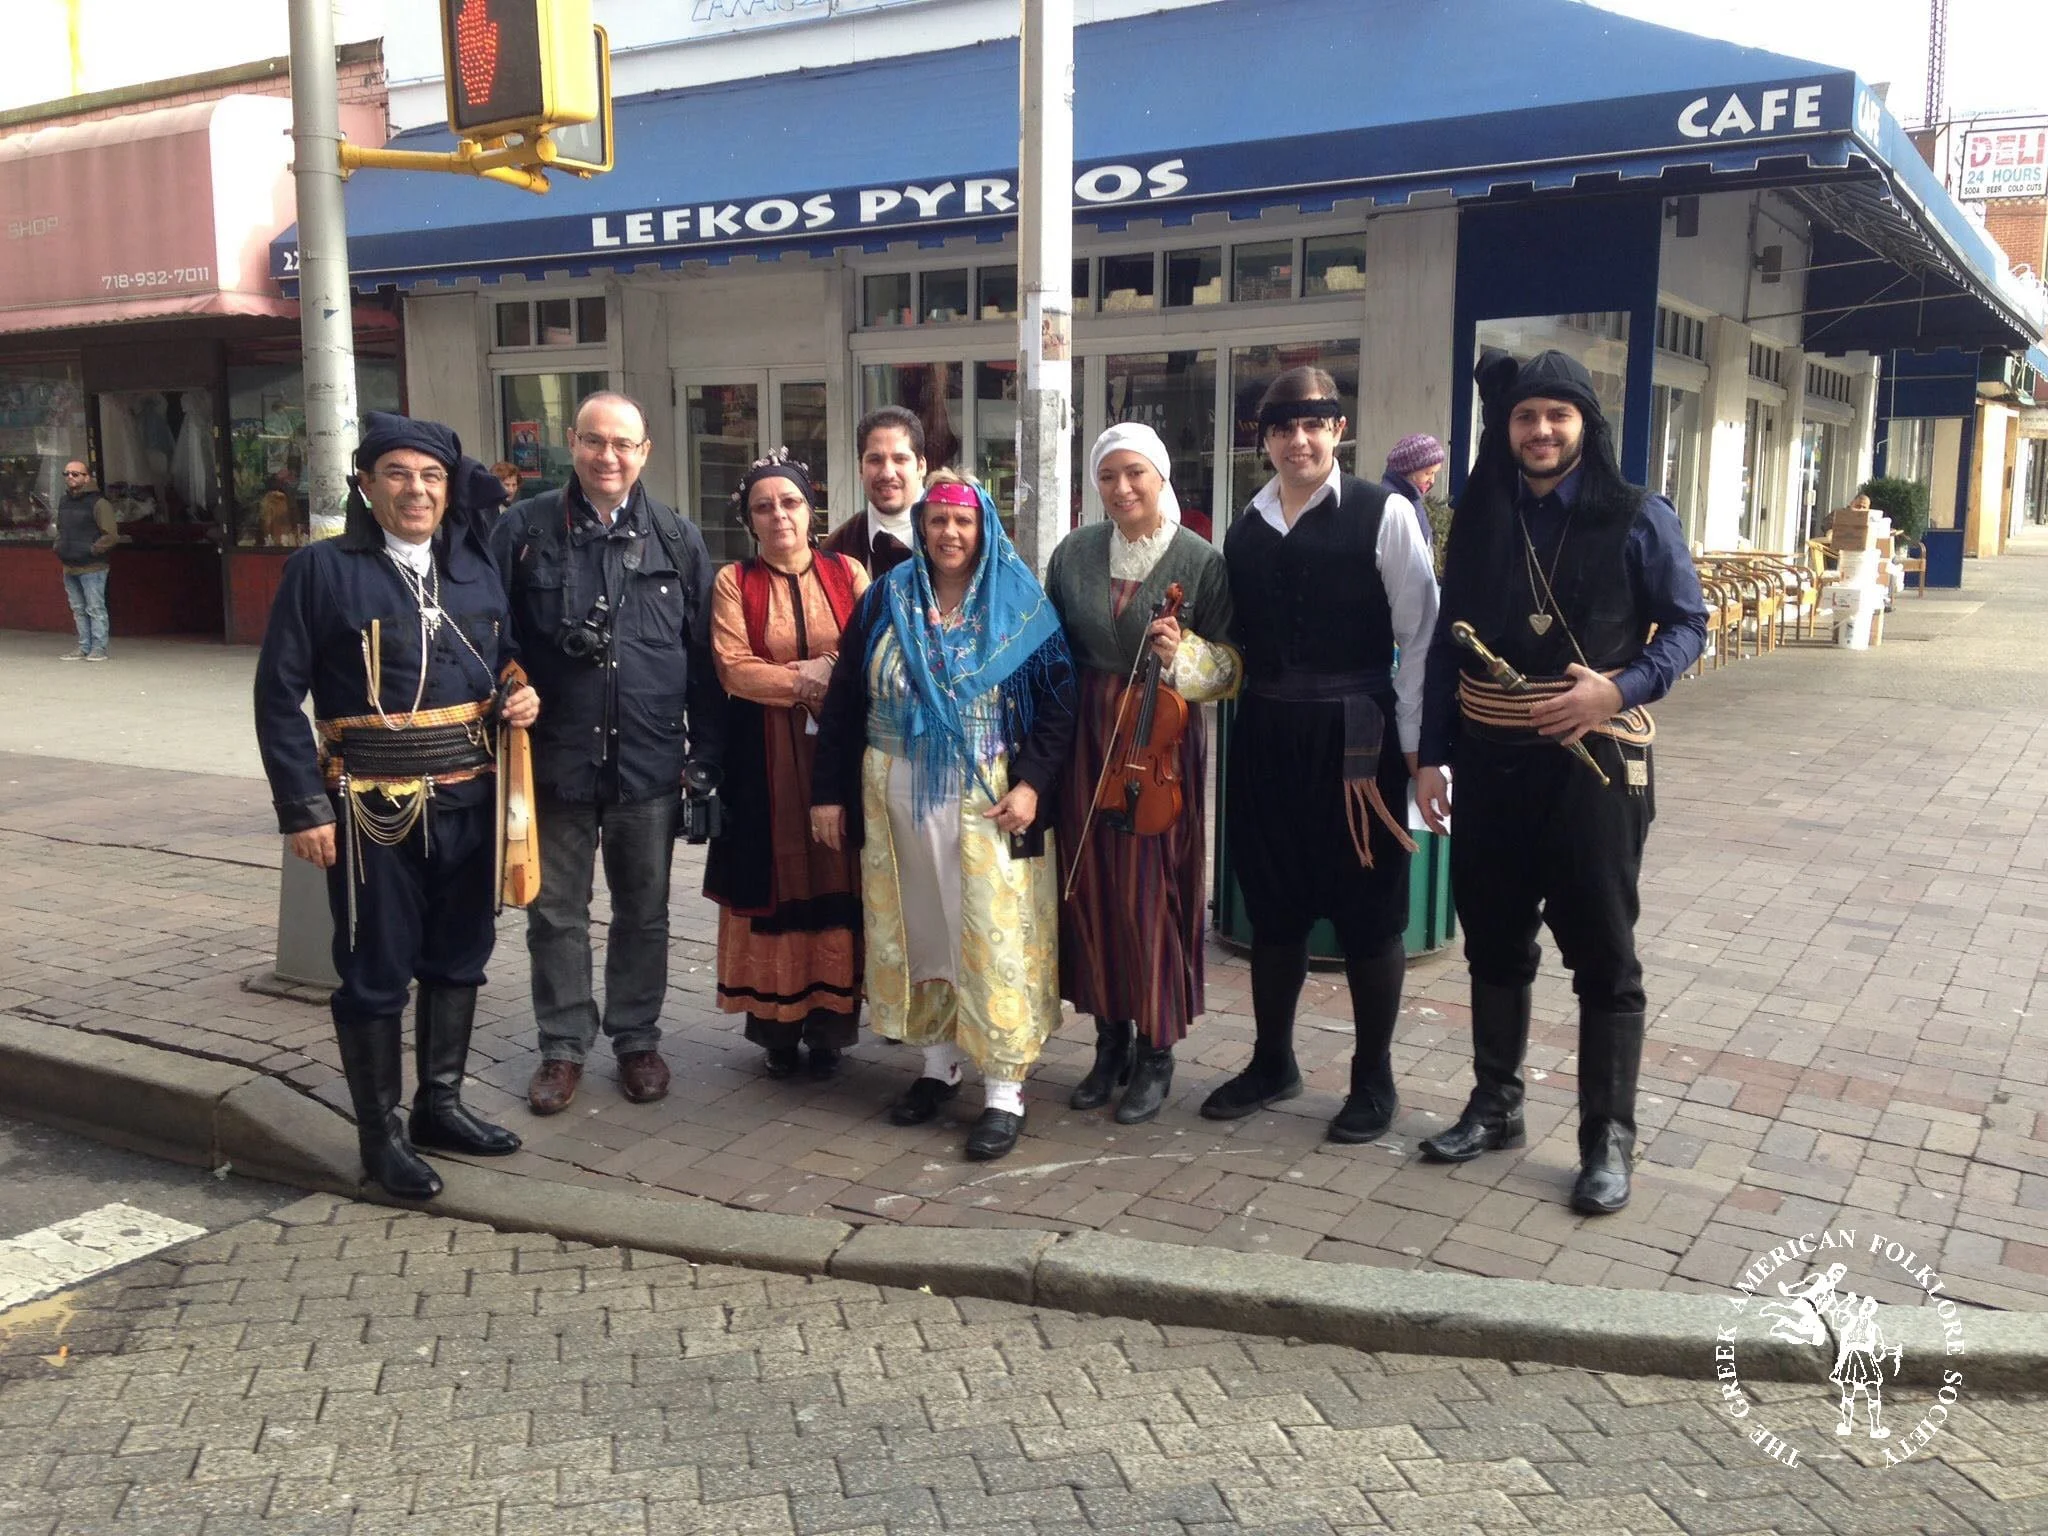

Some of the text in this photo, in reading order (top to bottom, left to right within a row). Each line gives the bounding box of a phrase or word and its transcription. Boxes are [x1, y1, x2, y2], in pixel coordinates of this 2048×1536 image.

[1677, 84, 1822, 138] CAFE
[1970, 133, 2046, 168] DELI
[1967, 167, 2041, 184] 24 HOURS
[1964, 183, 2042, 195] SODA BEER COLD CUTS
[592, 159, 1188, 247] LEFKOS PYROS
[8, 216, 60, 239] SHOP
[101, 266, 209, 290] 718-932-7011
